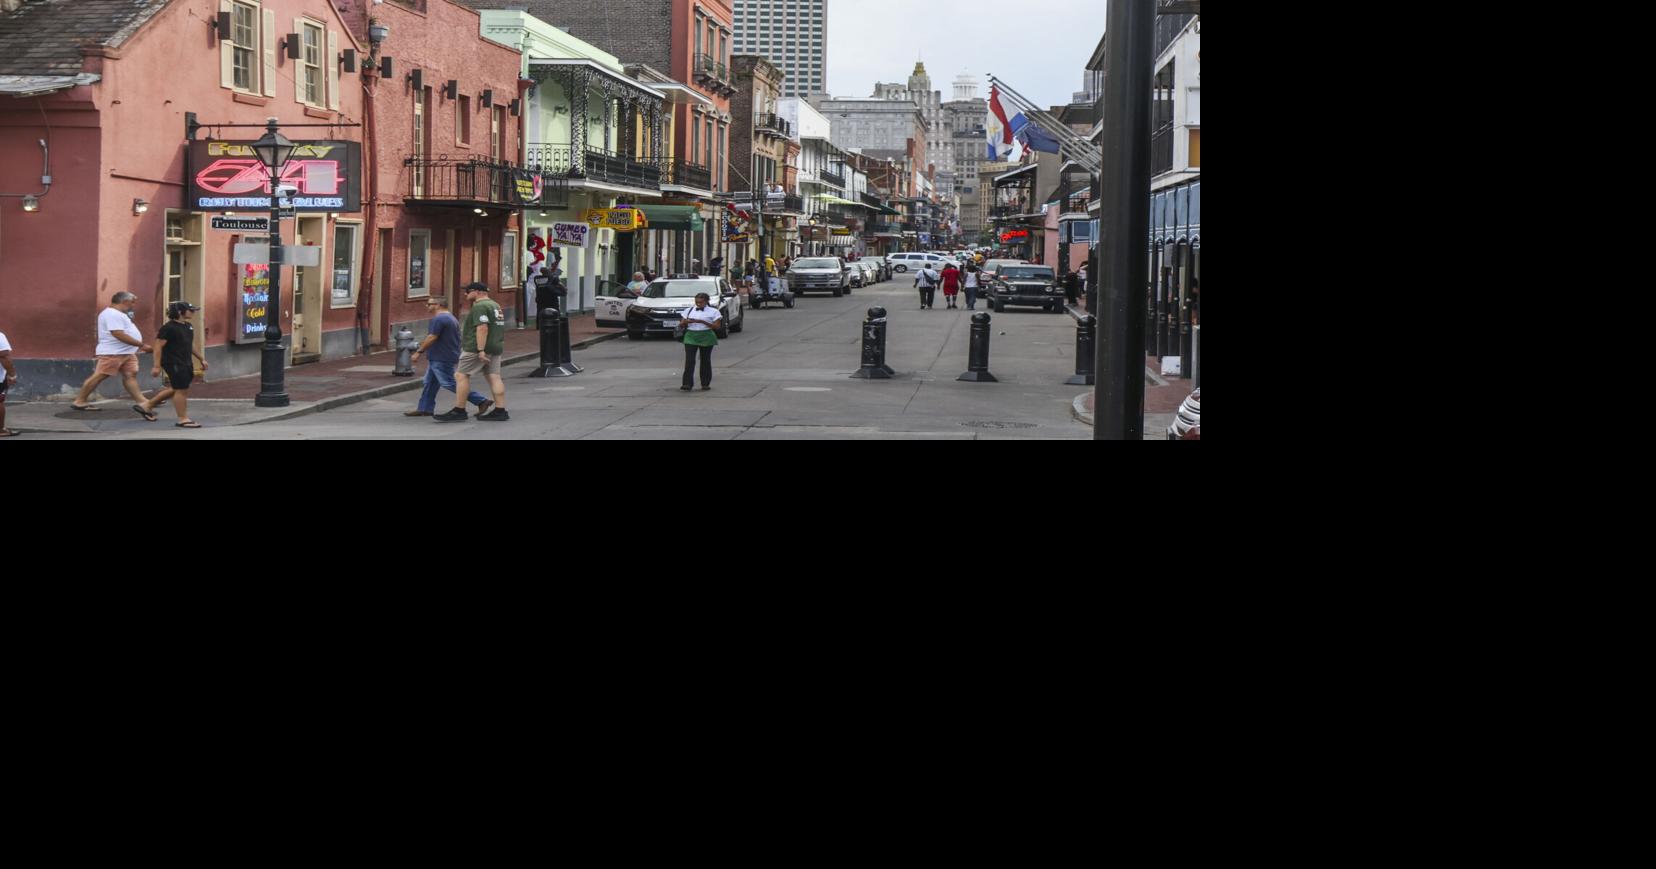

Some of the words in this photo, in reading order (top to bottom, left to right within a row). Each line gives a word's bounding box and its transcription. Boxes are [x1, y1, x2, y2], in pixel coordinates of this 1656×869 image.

[213, 220, 267, 229] Toulouse
[554, 223, 587, 234] GUMBO
[557, 231, 567, 240] YA
[571, 232, 582, 241] YA
